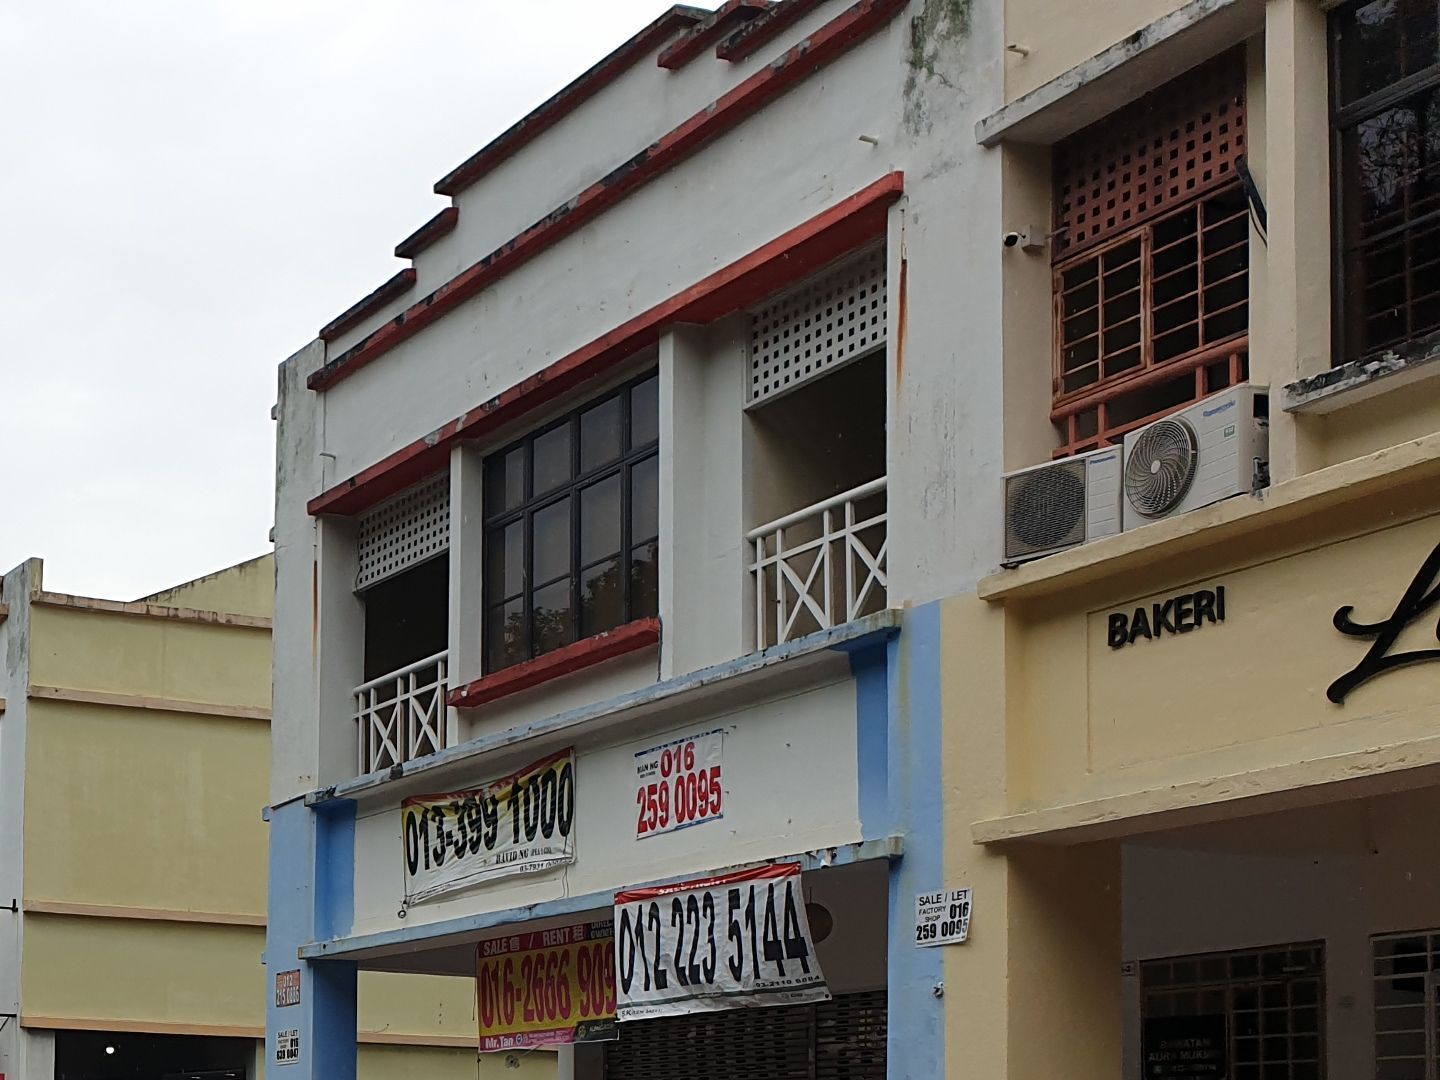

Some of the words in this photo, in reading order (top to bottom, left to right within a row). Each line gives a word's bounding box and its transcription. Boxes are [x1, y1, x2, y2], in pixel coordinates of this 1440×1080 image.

[1107, 586, 1225, 649] BAKERI
[661, 742, 695, 778] 016
[637, 781, 670, 834] 259
[675, 766, 722, 823] 0095
[406, 794, 499, 876] 013-399
[508, 762, 573, 844] 1000
[919, 894, 942, 906] SALE
[952, 890, 968, 901] LET
[919, 906, 947, 915] FACTORY
[949, 902, 969, 919] 016
[916, 923, 937, 941] 259
[941, 918, 968, 937] 0095
[925, 915, 941, 923] SHOP
[483, 939, 508, 956] SALE
[542, 928, 571, 947] RENT
[573, 925, 584, 940] 租
[619, 902, 668, 995] 012
[671, 891, 717, 987] 223
[728, 881, 810, 982] 5144
[481, 949, 571, 1028] 016-2666
[577, 941, 617, 1018] 909
[290, 1029, 298, 1037] LET
